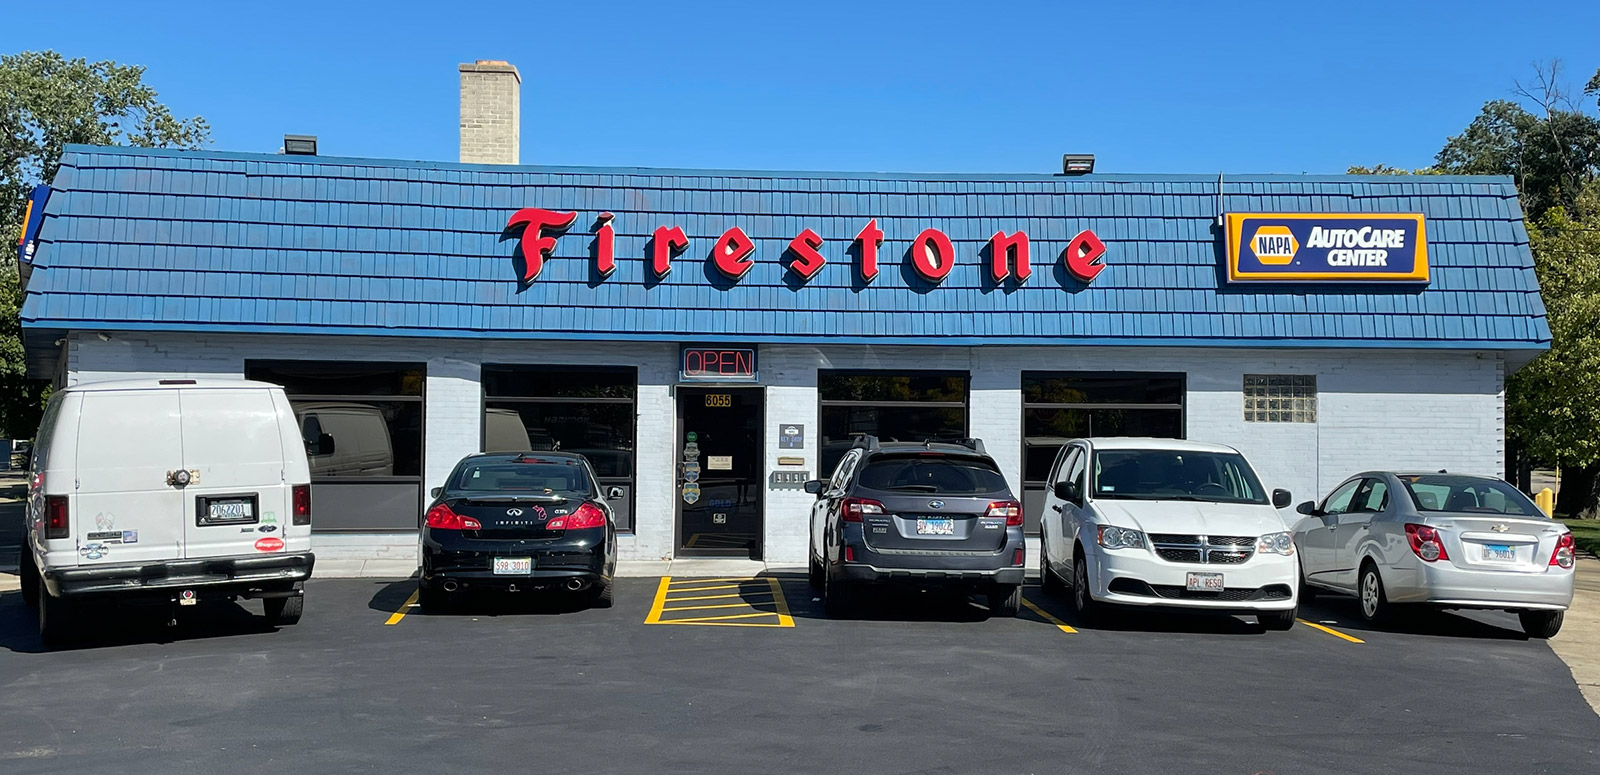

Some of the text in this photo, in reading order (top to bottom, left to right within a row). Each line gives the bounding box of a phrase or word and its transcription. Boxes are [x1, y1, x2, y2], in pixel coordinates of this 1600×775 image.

[507, 207, 1107, 286] Firestone
[1258, 236, 1292, 255] NAPA
[1327, 249, 1388, 267] CENTER
[686, 350, 752, 376] OPEN
[706, 395, 731, 407] 6055
[512, 561, 529, 570] 3010
